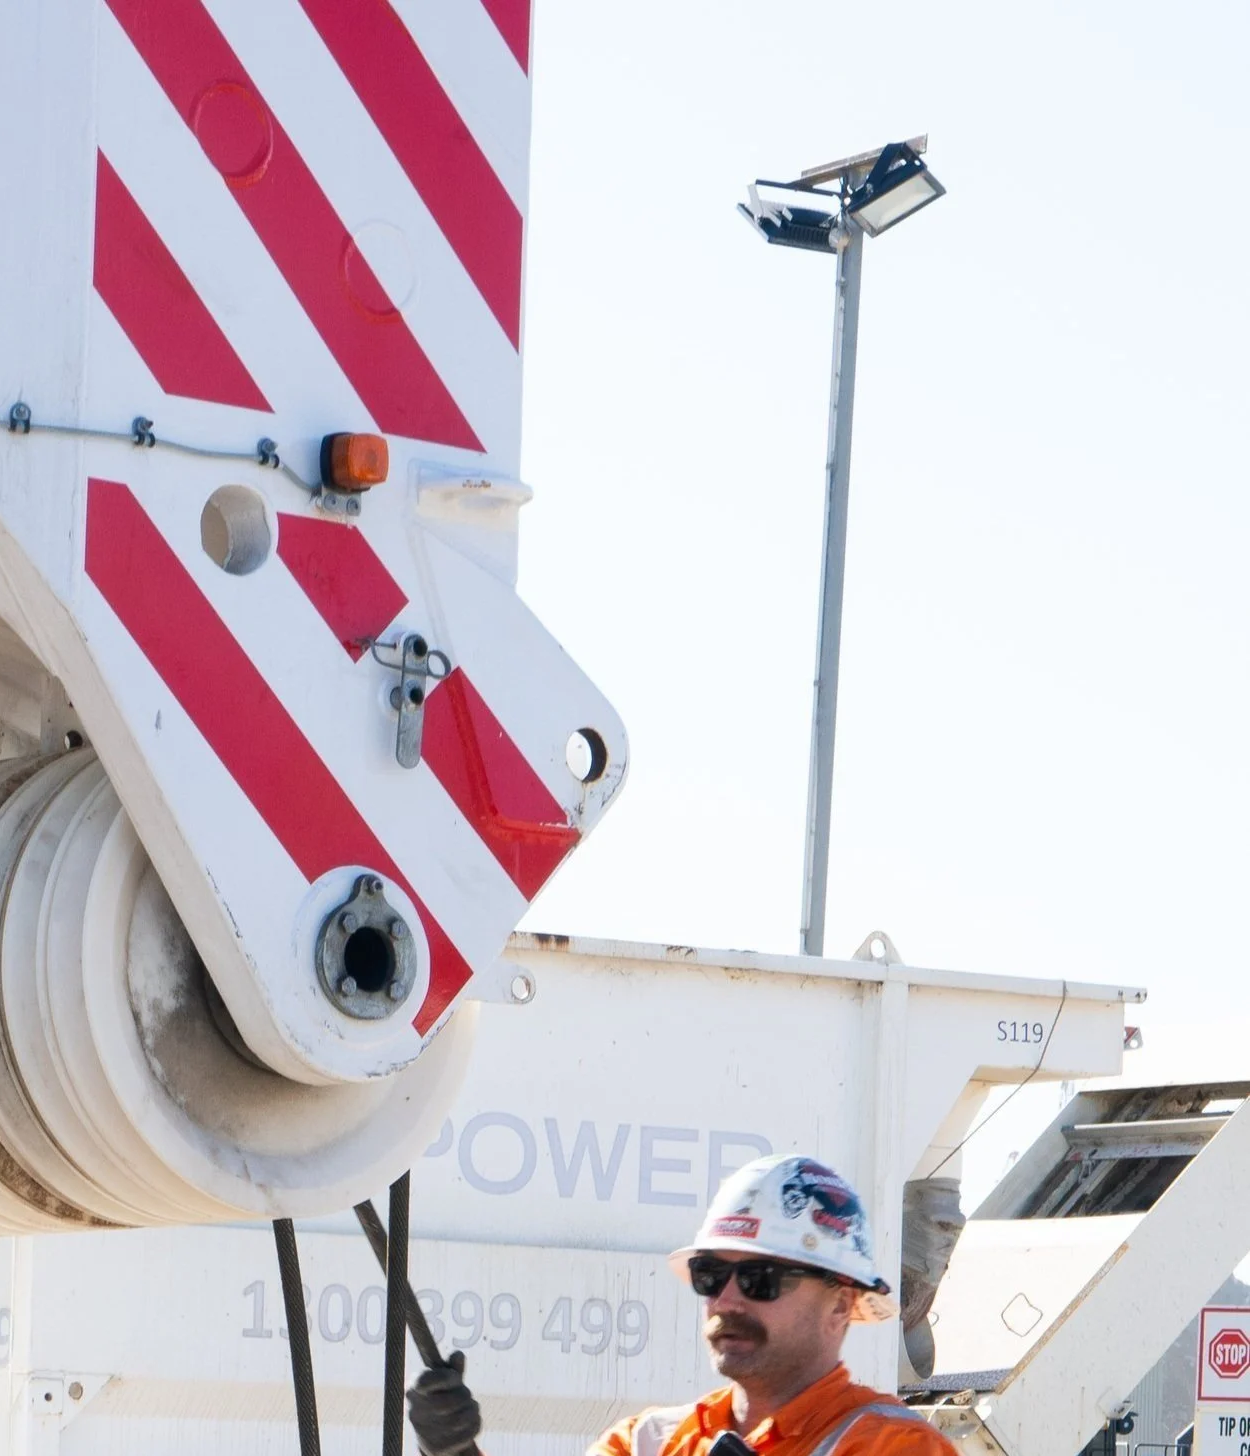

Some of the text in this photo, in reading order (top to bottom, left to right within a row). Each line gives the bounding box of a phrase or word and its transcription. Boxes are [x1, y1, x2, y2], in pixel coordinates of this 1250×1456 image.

[997, 1020, 1044, 1044] S119
[541, 1296, 650, 1358] 499
[1215, 1343, 1246, 1366] STOP
[1218, 1416, 1236, 1437] TIP
